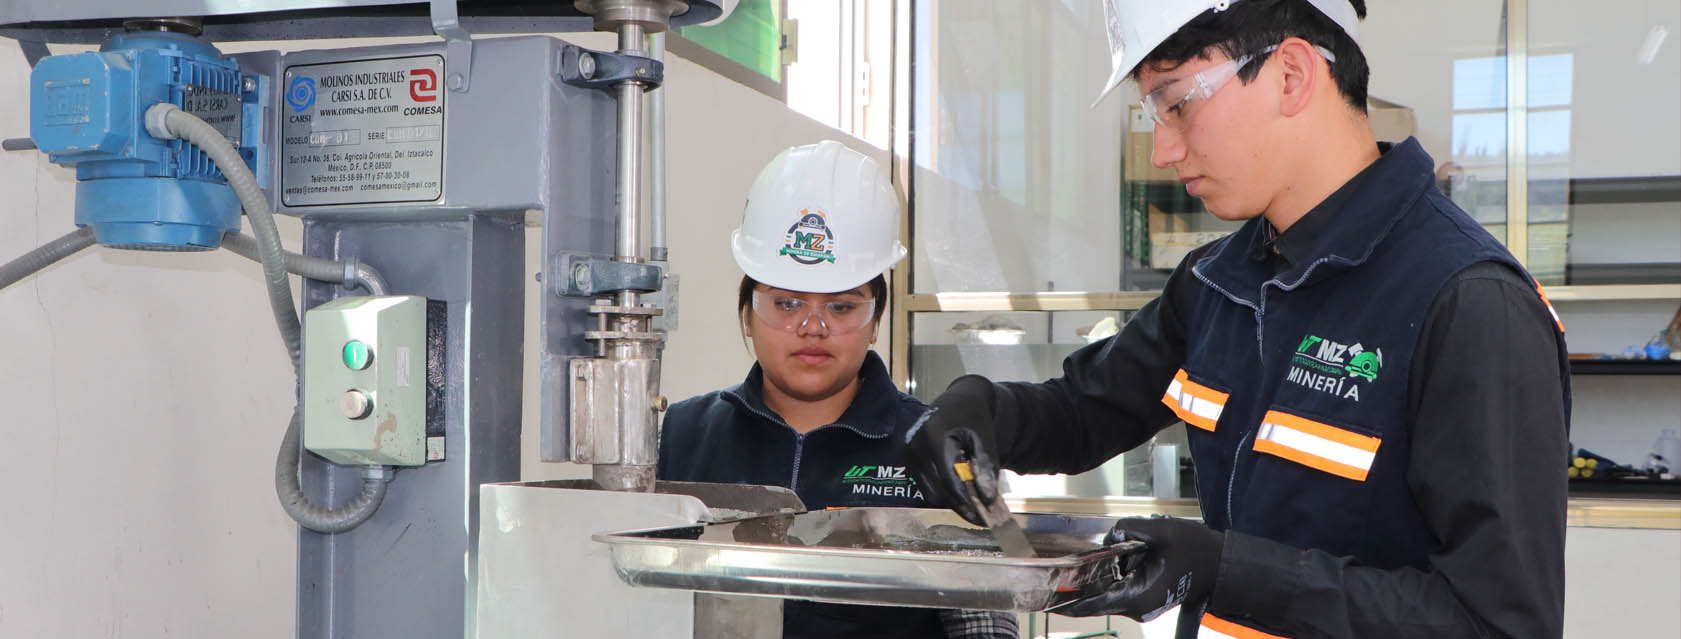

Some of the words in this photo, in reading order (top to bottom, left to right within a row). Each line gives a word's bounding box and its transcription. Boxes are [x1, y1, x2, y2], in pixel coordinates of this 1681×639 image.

[320, 74, 353, 88] MOLINOS
[355, 70, 405, 86] INDUSTRIALES
[331, 90, 352, 103] CARSI
[353, 89, 367, 101] S.A.
[368, 88, 378, 100] DE
[379, 87, 392, 99] C.V.
[320, 104, 399, 117] www.comesa-mex.com
[403, 105, 442, 117] COMESA
[289, 115, 312, 124] CARSI
[286, 136, 309, 145] MODELO
[368, 131, 385, 140] SERIE
[407, 148, 433, 157] Iztacalco
[794, 230, 825, 251] MZ
[1287, 366, 1360, 402] MINERÍA
[852, 483, 925, 501] MINERÍA
